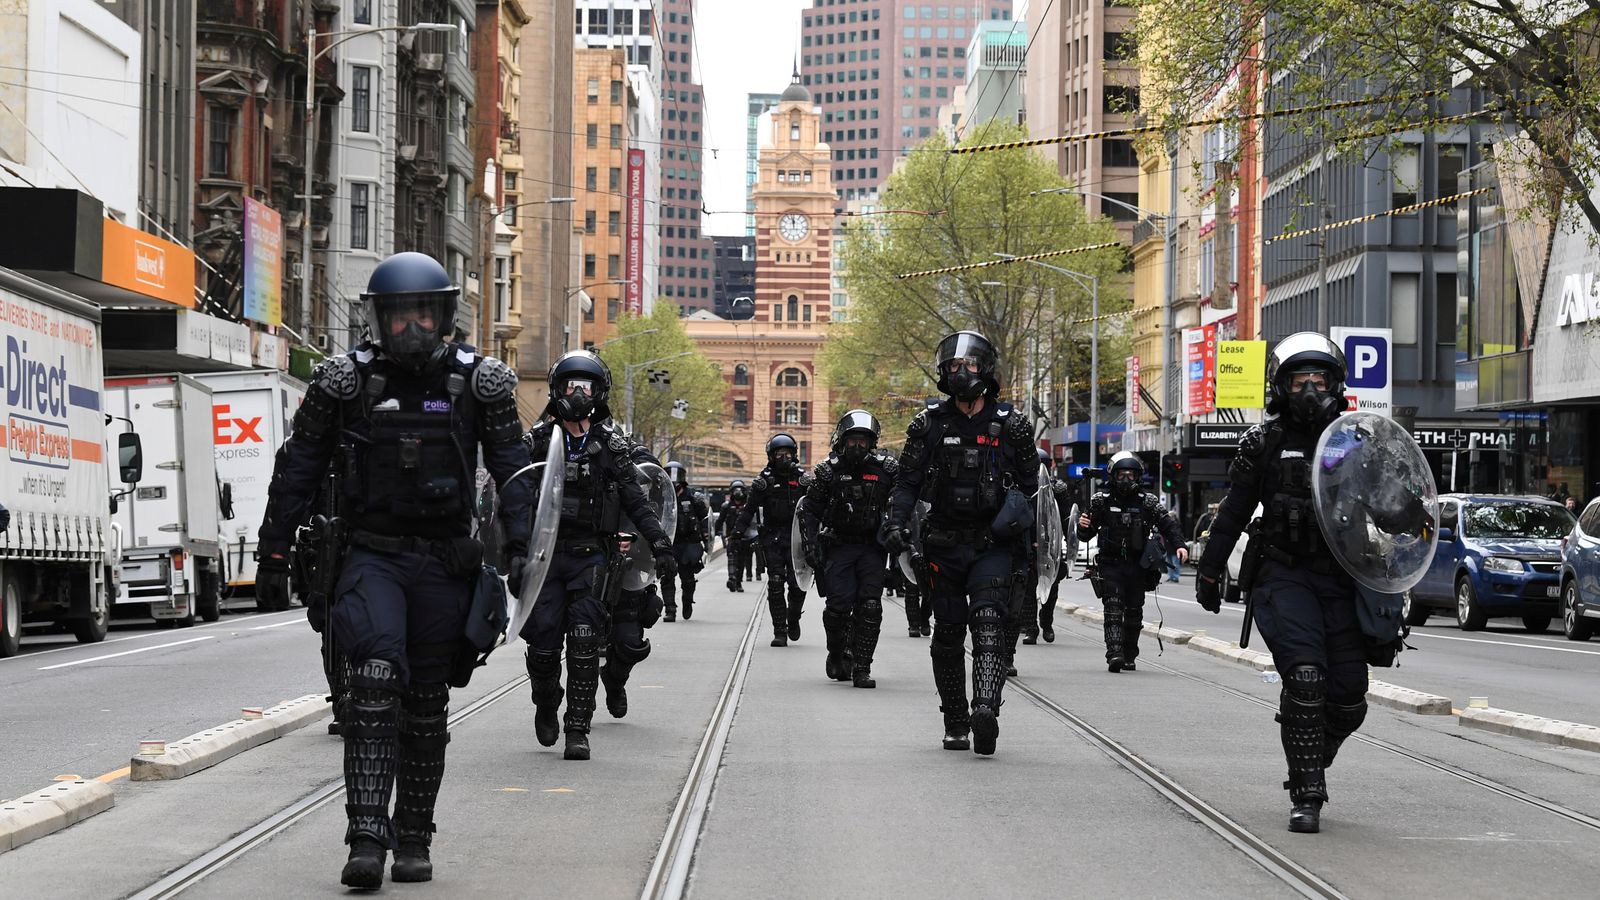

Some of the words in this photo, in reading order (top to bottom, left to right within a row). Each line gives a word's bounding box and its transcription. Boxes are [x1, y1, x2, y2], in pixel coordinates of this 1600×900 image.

[632, 170, 641, 196] ROYAL
[629, 239, 639, 282] INSTITUTE
[629, 283, 638, 295] OF
[31, 311, 48, 335] STATE
[49, 321, 60, 338] and
[61, 321, 93, 349] NATIONWIDE
[1220, 344, 1245, 354] Lease
[1355, 345, 1379, 379] P
[7, 335, 67, 418] Direct
[1219, 364, 1243, 374] Office
[1205, 370, 1213, 408] SALE
[1359, 400, 1388, 409] Wilson
[10, 418, 38, 460] Freight
[39, 425, 69, 463] Express
[1200, 431, 1238, 439] ELIZABETH
